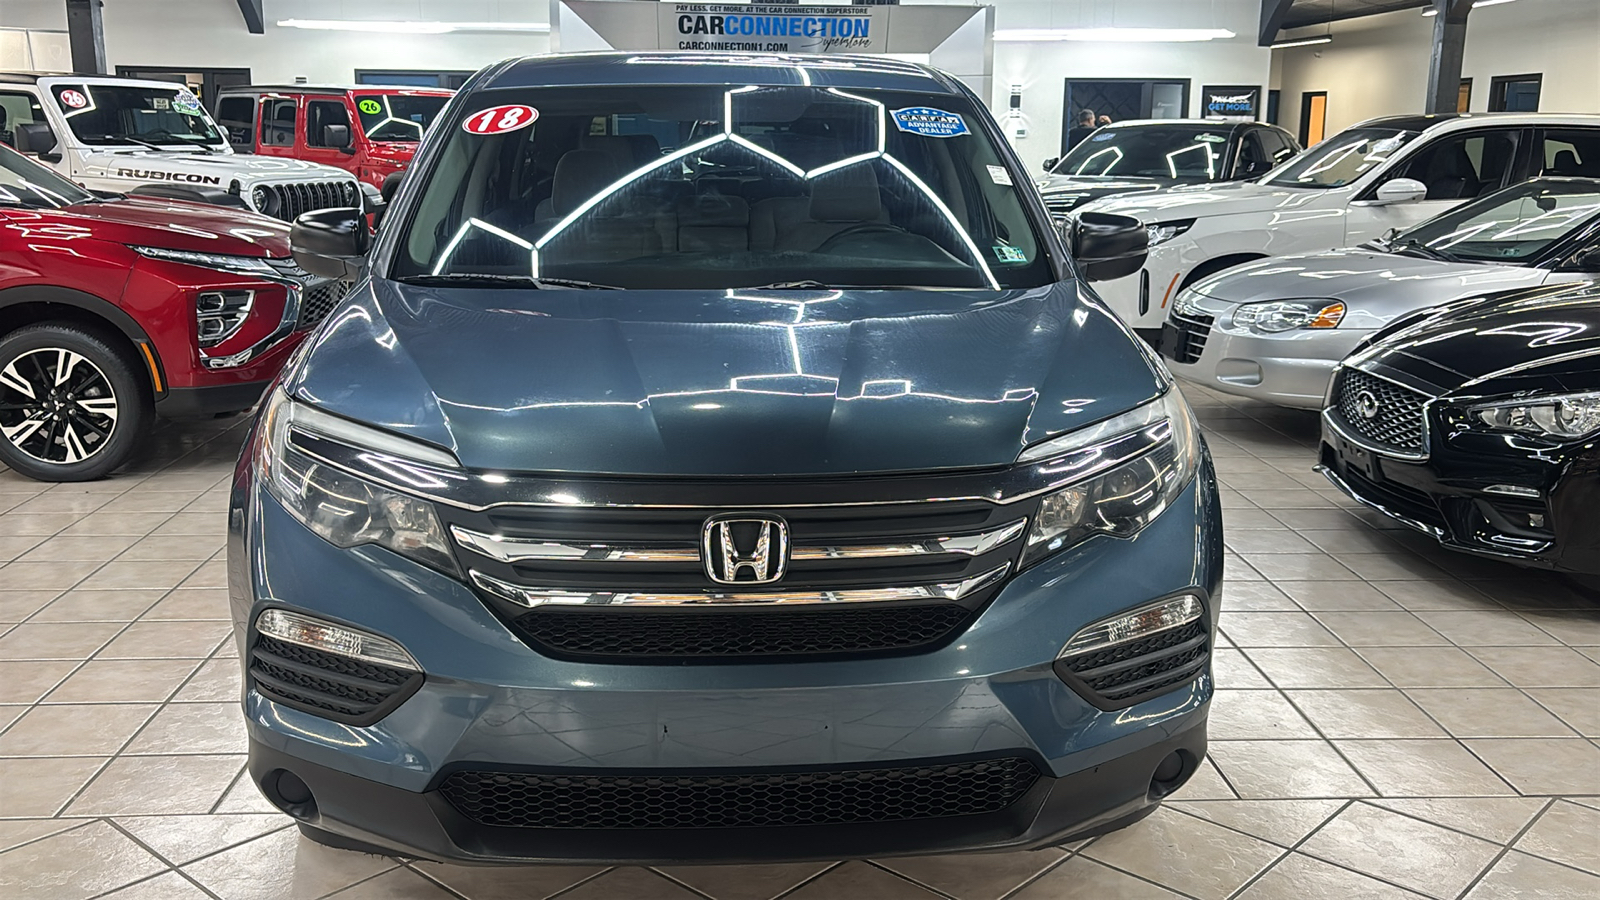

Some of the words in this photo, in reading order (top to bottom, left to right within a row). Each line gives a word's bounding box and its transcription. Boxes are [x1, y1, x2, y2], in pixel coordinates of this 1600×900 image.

[801, 28, 872, 52] Superstore
[679, 41, 788, 52] CARCONNECTION1.COM
[64, 93, 83, 108] 26
[364, 102, 377, 111] 26
[1208, 103, 1225, 111] GET
[1226, 103, 1252, 111] MORE.
[478, 108, 525, 132] 18
[900, 114, 960, 124] CARFAX
[907, 121, 959, 130] ADVANTAGE
[919, 127, 953, 135] DEALER
[117, 168, 221, 185] RUBICON
